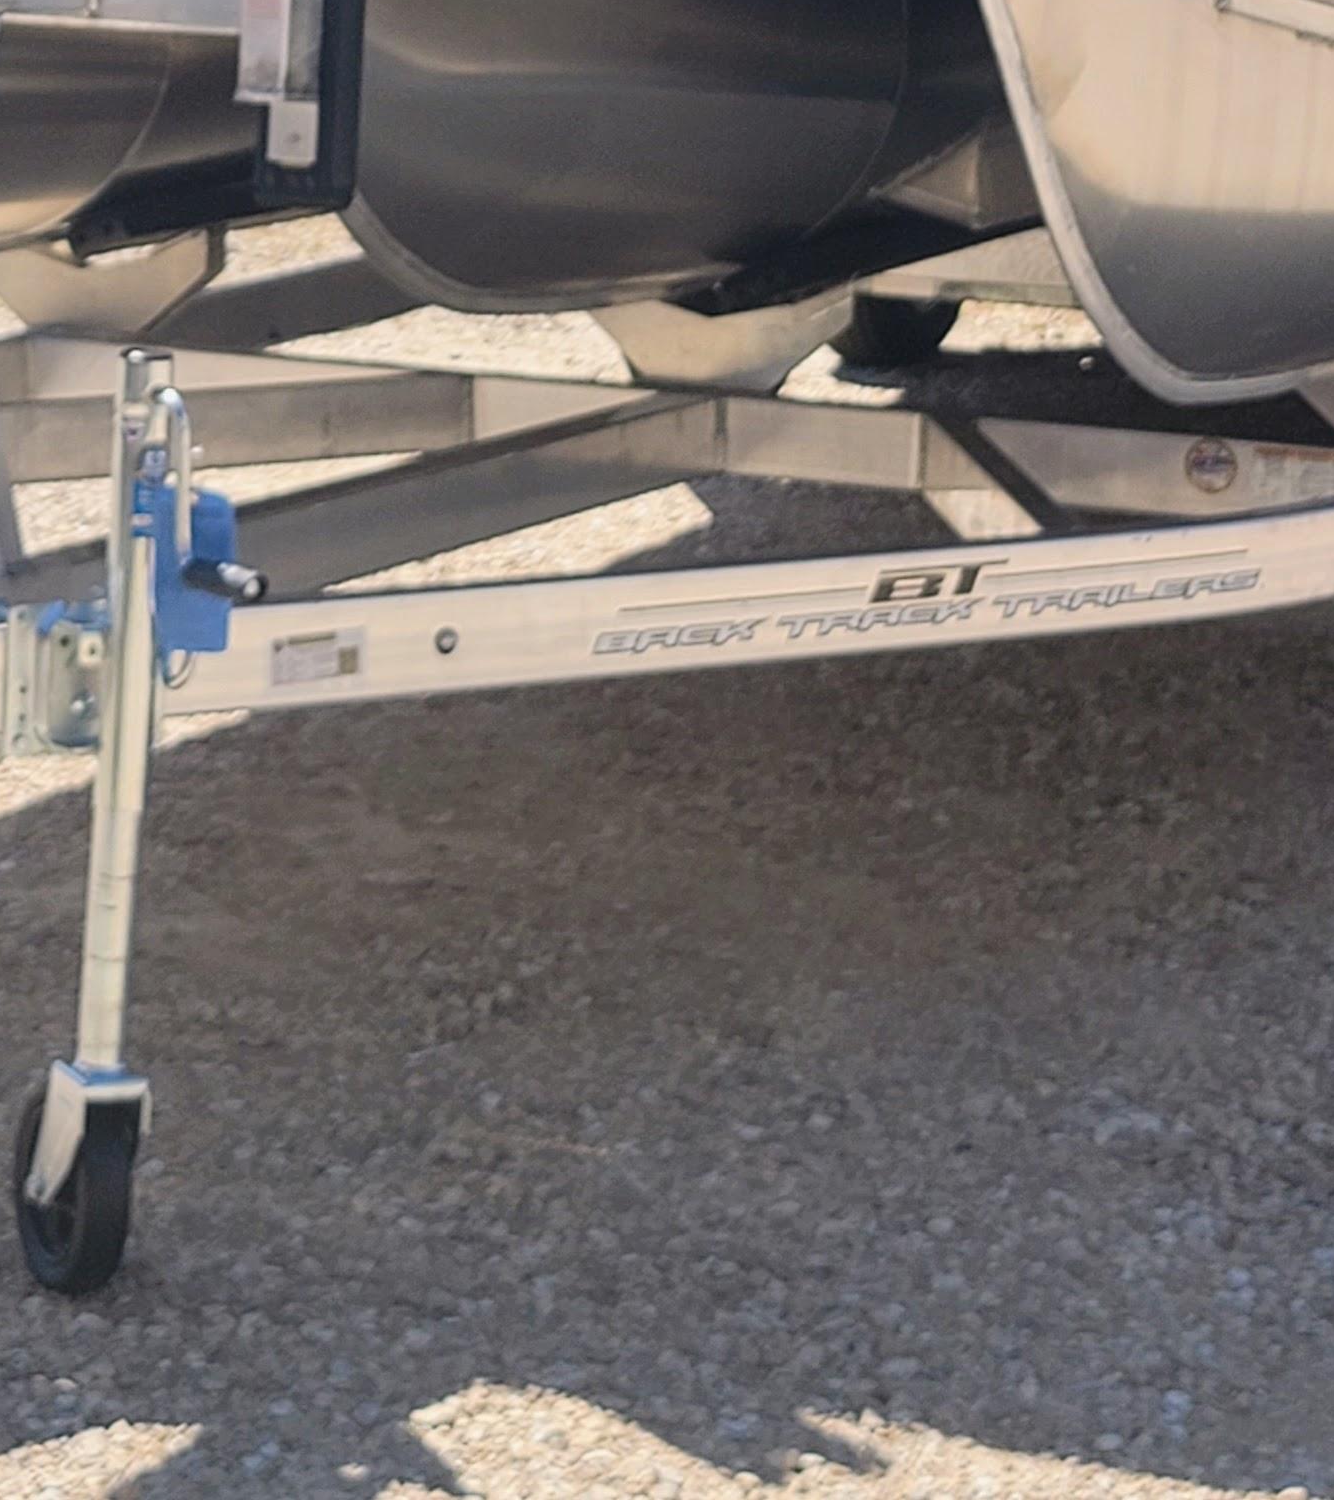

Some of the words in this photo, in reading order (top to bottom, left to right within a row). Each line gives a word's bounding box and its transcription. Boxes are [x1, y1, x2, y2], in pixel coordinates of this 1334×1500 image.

[592, 615, 770, 654] BACK
[777, 597, 985, 639] TRACK
[993, 568, 1262, 618] TRAILERS
[868, 558, 1009, 603] BT
